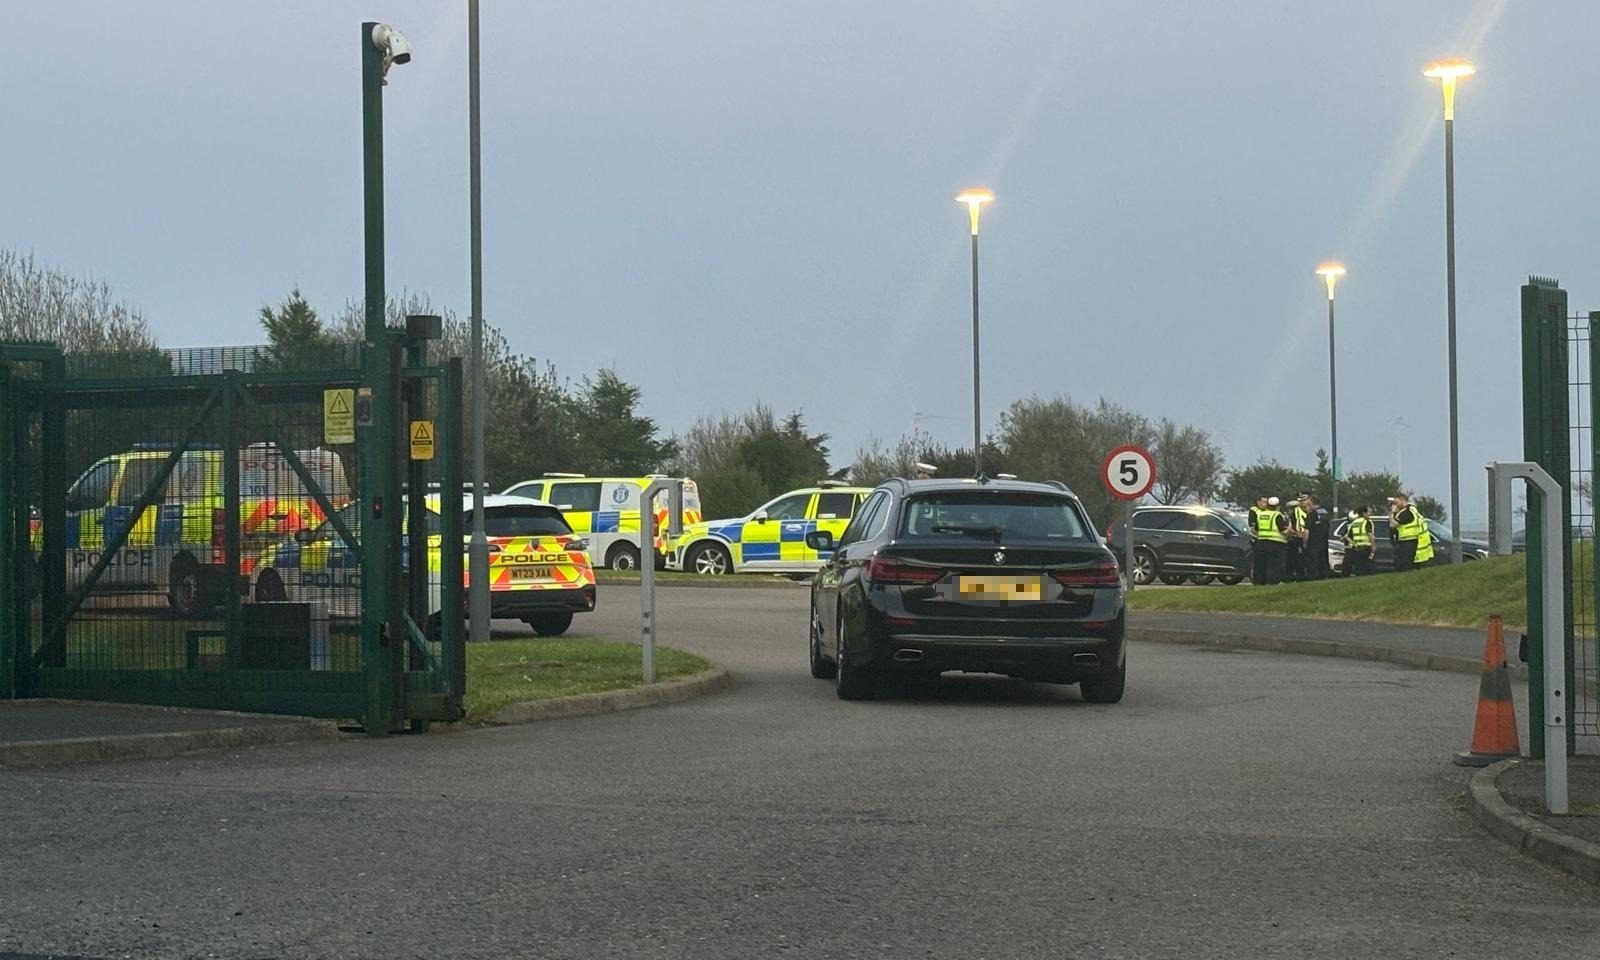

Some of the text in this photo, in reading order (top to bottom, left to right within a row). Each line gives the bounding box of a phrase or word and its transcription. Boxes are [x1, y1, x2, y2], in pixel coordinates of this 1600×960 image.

[1120, 459, 1138, 486] 5
[501, 554, 568, 563] POLICE
[302, 573, 362, 586] POLIC
